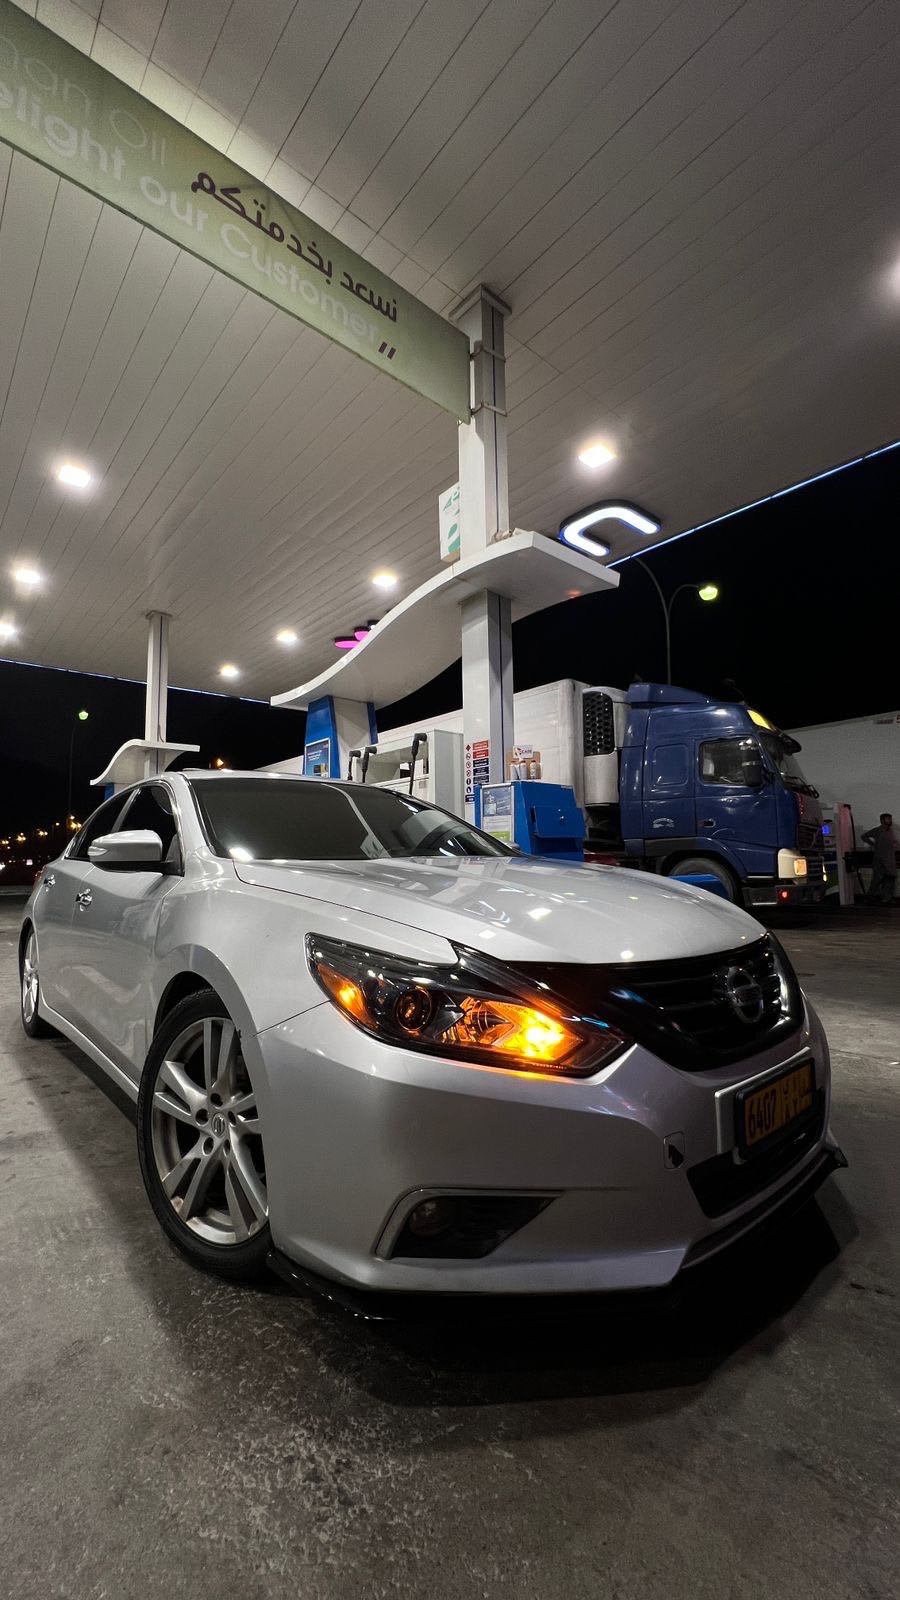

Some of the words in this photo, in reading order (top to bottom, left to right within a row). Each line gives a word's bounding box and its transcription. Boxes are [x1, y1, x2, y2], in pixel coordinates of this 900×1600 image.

[139, 175, 208, 232] our
[220, 222, 378, 341] Customer
[190, 171, 333, 285] بخدمتكم
[340, 271, 397, 323] نسعد
[748, 1089, 777, 1138] 6407
